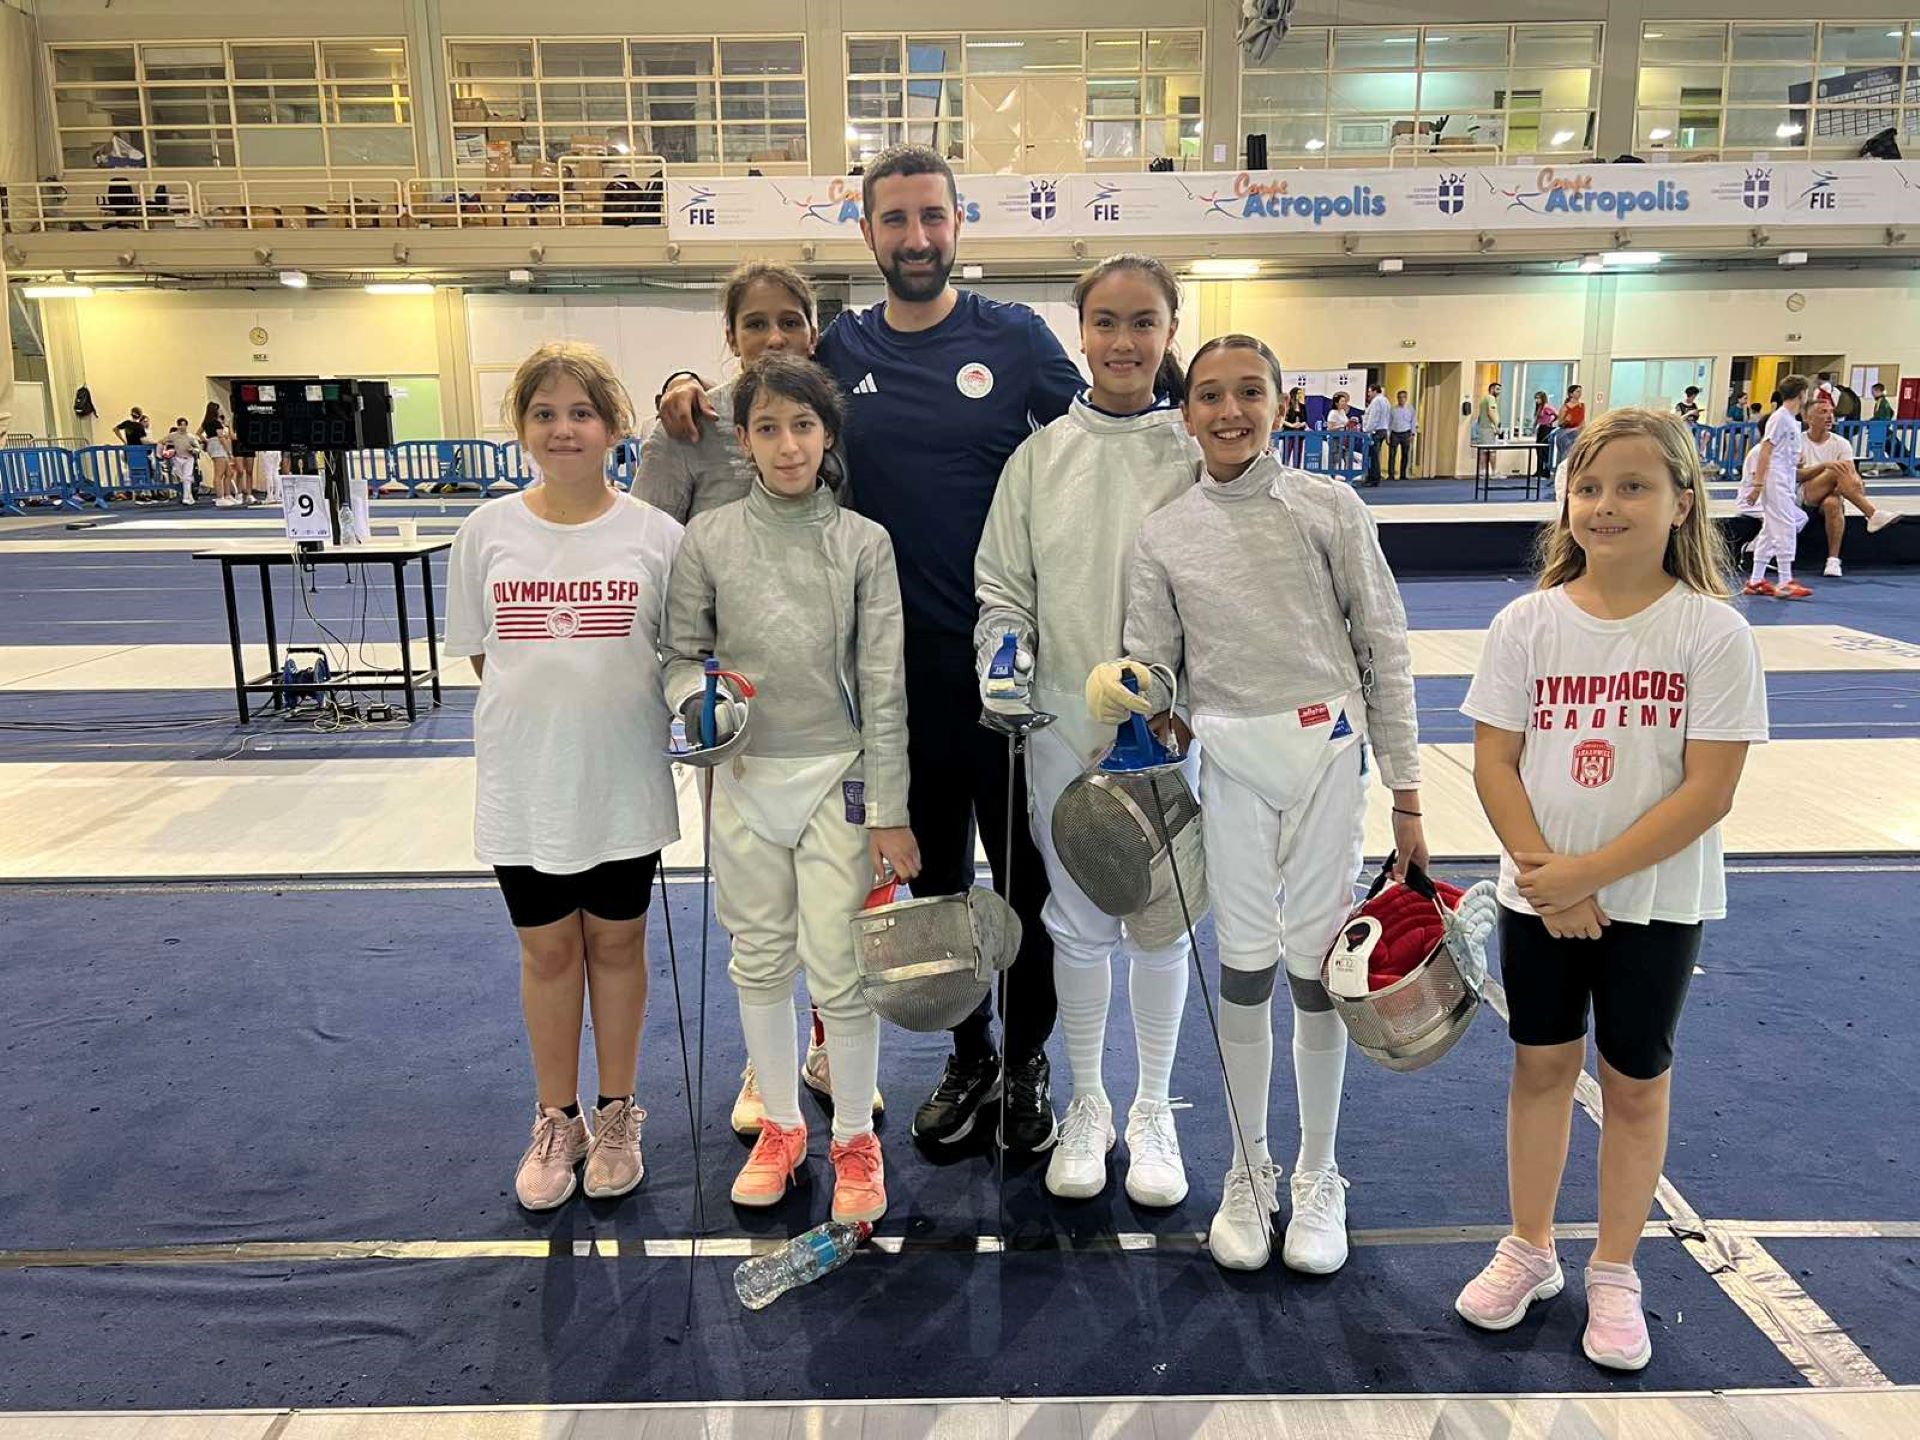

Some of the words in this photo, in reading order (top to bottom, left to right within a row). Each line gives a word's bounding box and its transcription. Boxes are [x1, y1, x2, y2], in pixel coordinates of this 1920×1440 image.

[1242, 185, 1388, 225] Acropolis
[1543, 180, 1690, 221] Acropolis
[1809, 192, 1836, 210] FIE
[689, 209, 715, 225] FIE
[1093, 205, 1120, 222] FIE
[298, 494, 314, 518] 9
[492, 580, 603, 604] OLYMPIACOS
[607, 580, 639, 602] SFP
